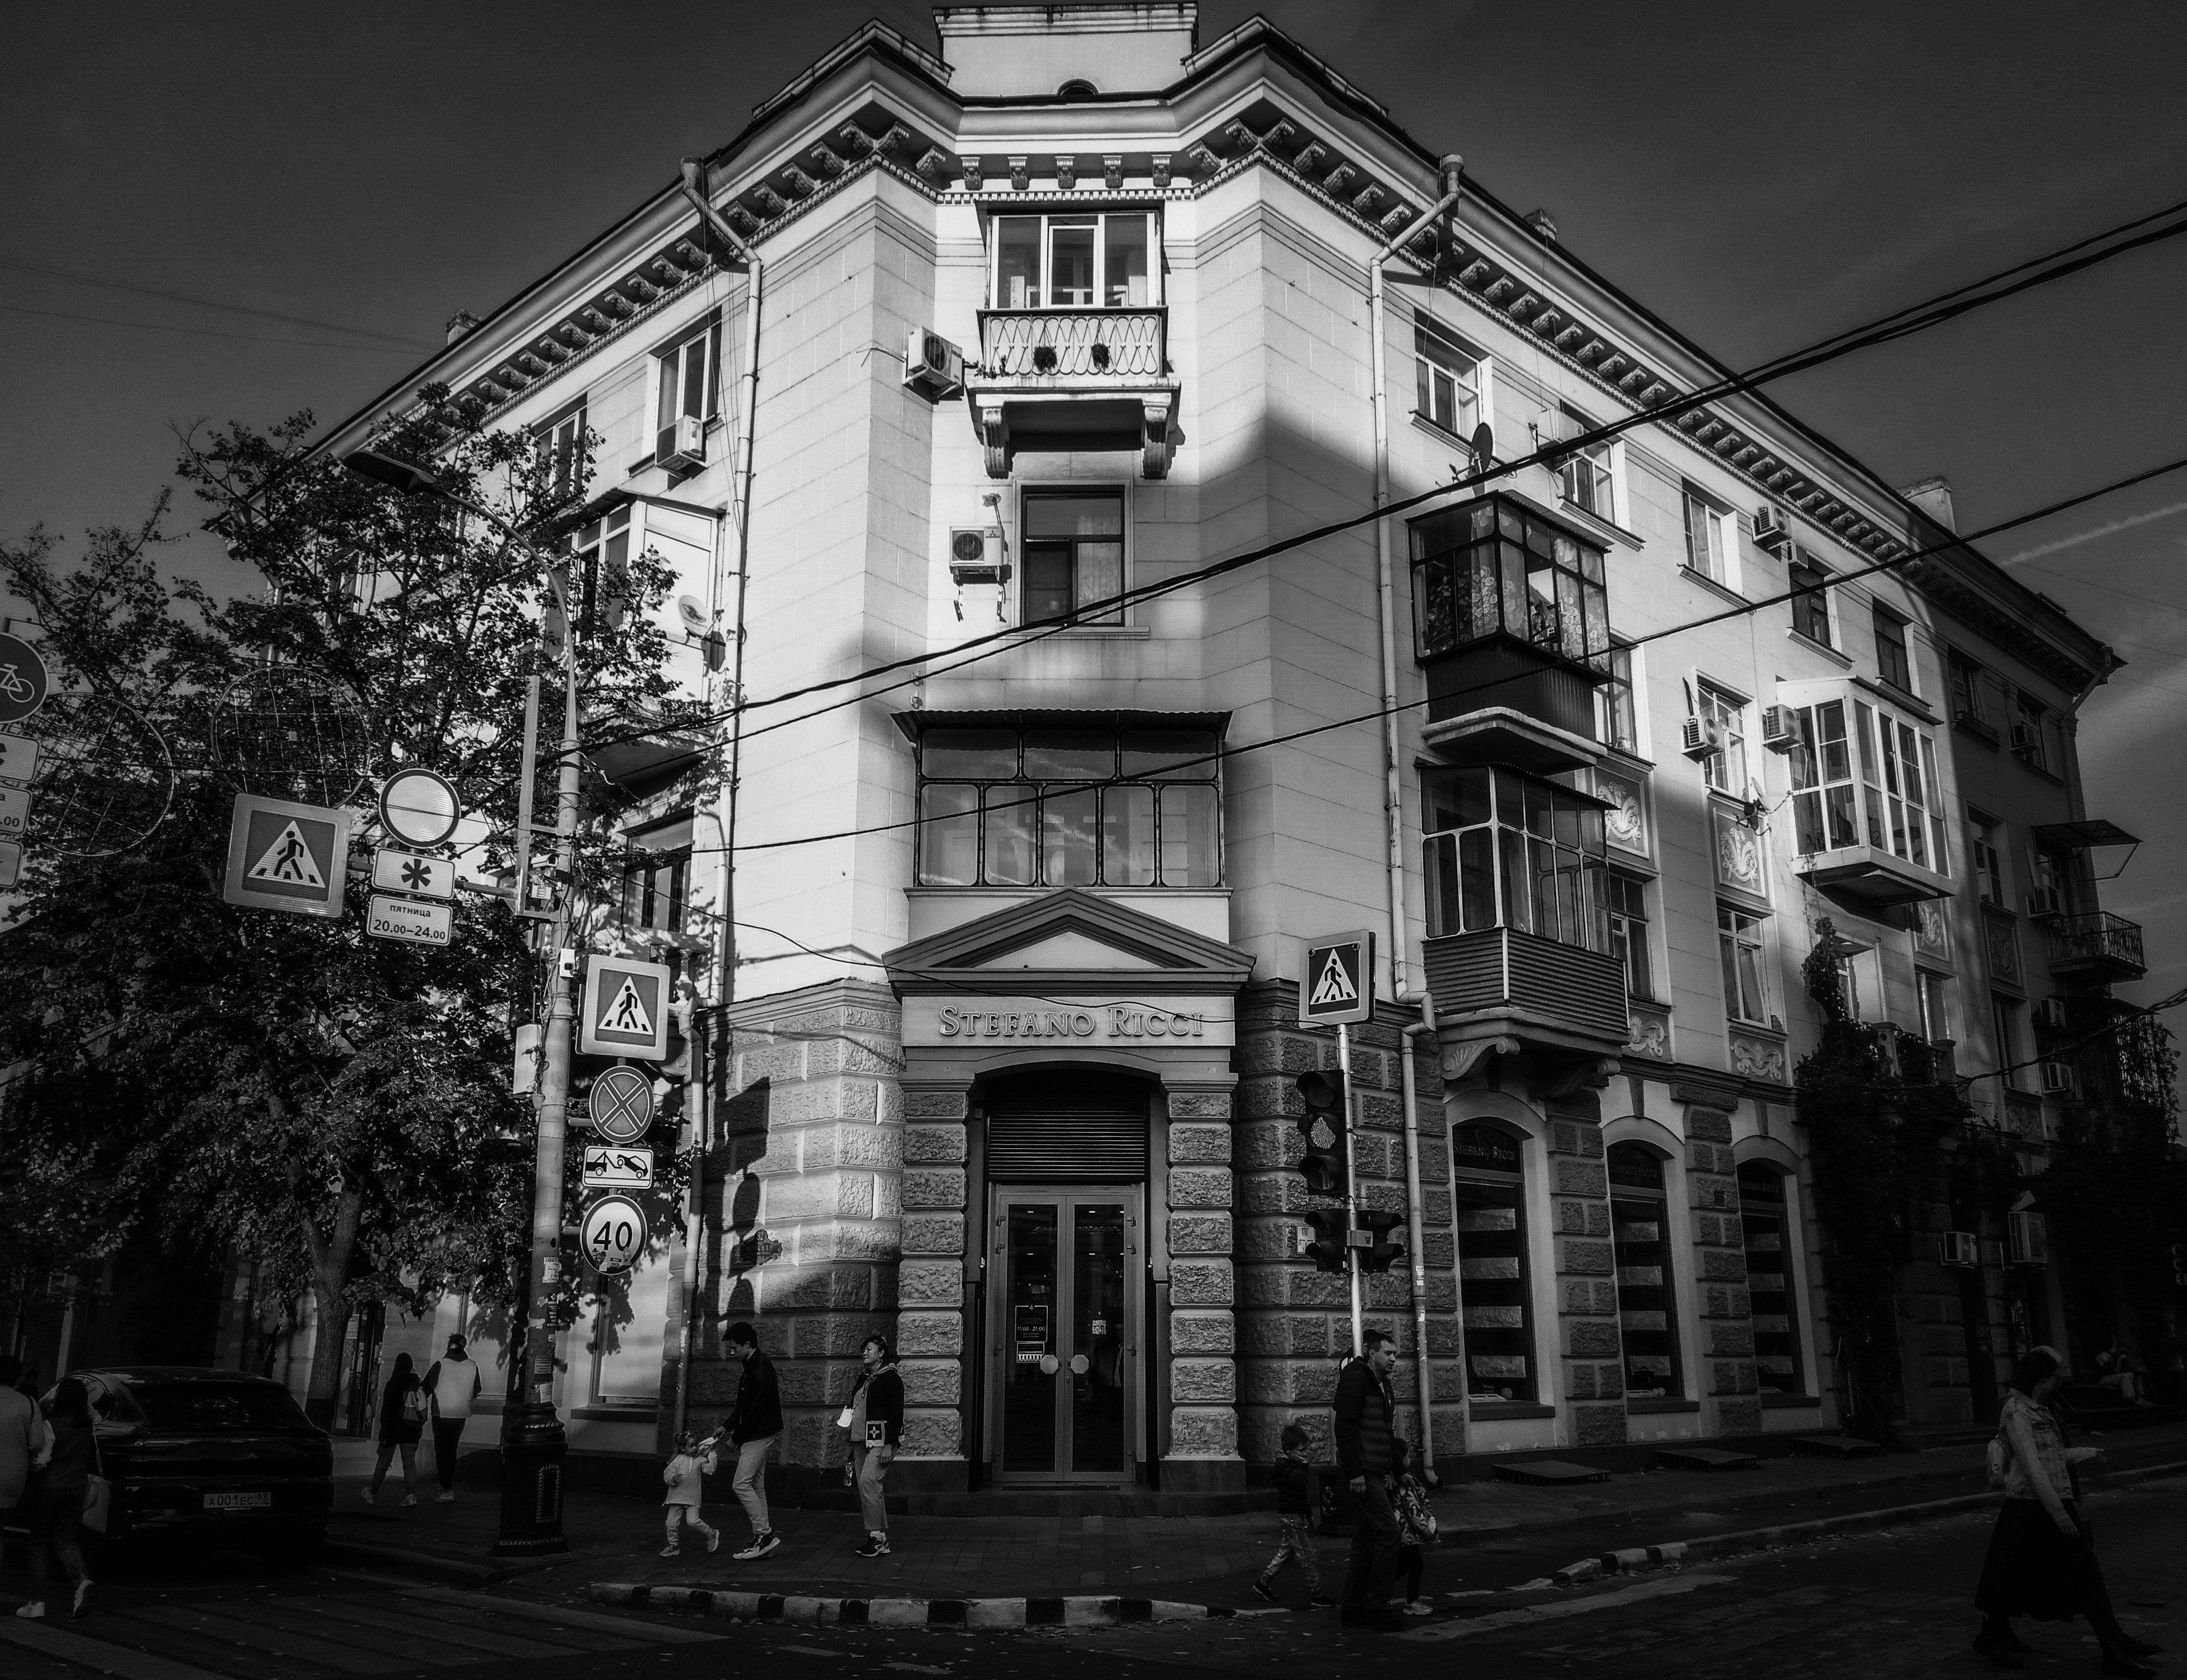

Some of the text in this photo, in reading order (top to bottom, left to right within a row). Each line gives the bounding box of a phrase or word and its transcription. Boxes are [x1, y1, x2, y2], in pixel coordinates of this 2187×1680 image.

[390, 905, 431, 918] пятница
[940, 1006, 1203, 1035] STEFANO RICCI
[593, 1221, 632, 1251] 40
